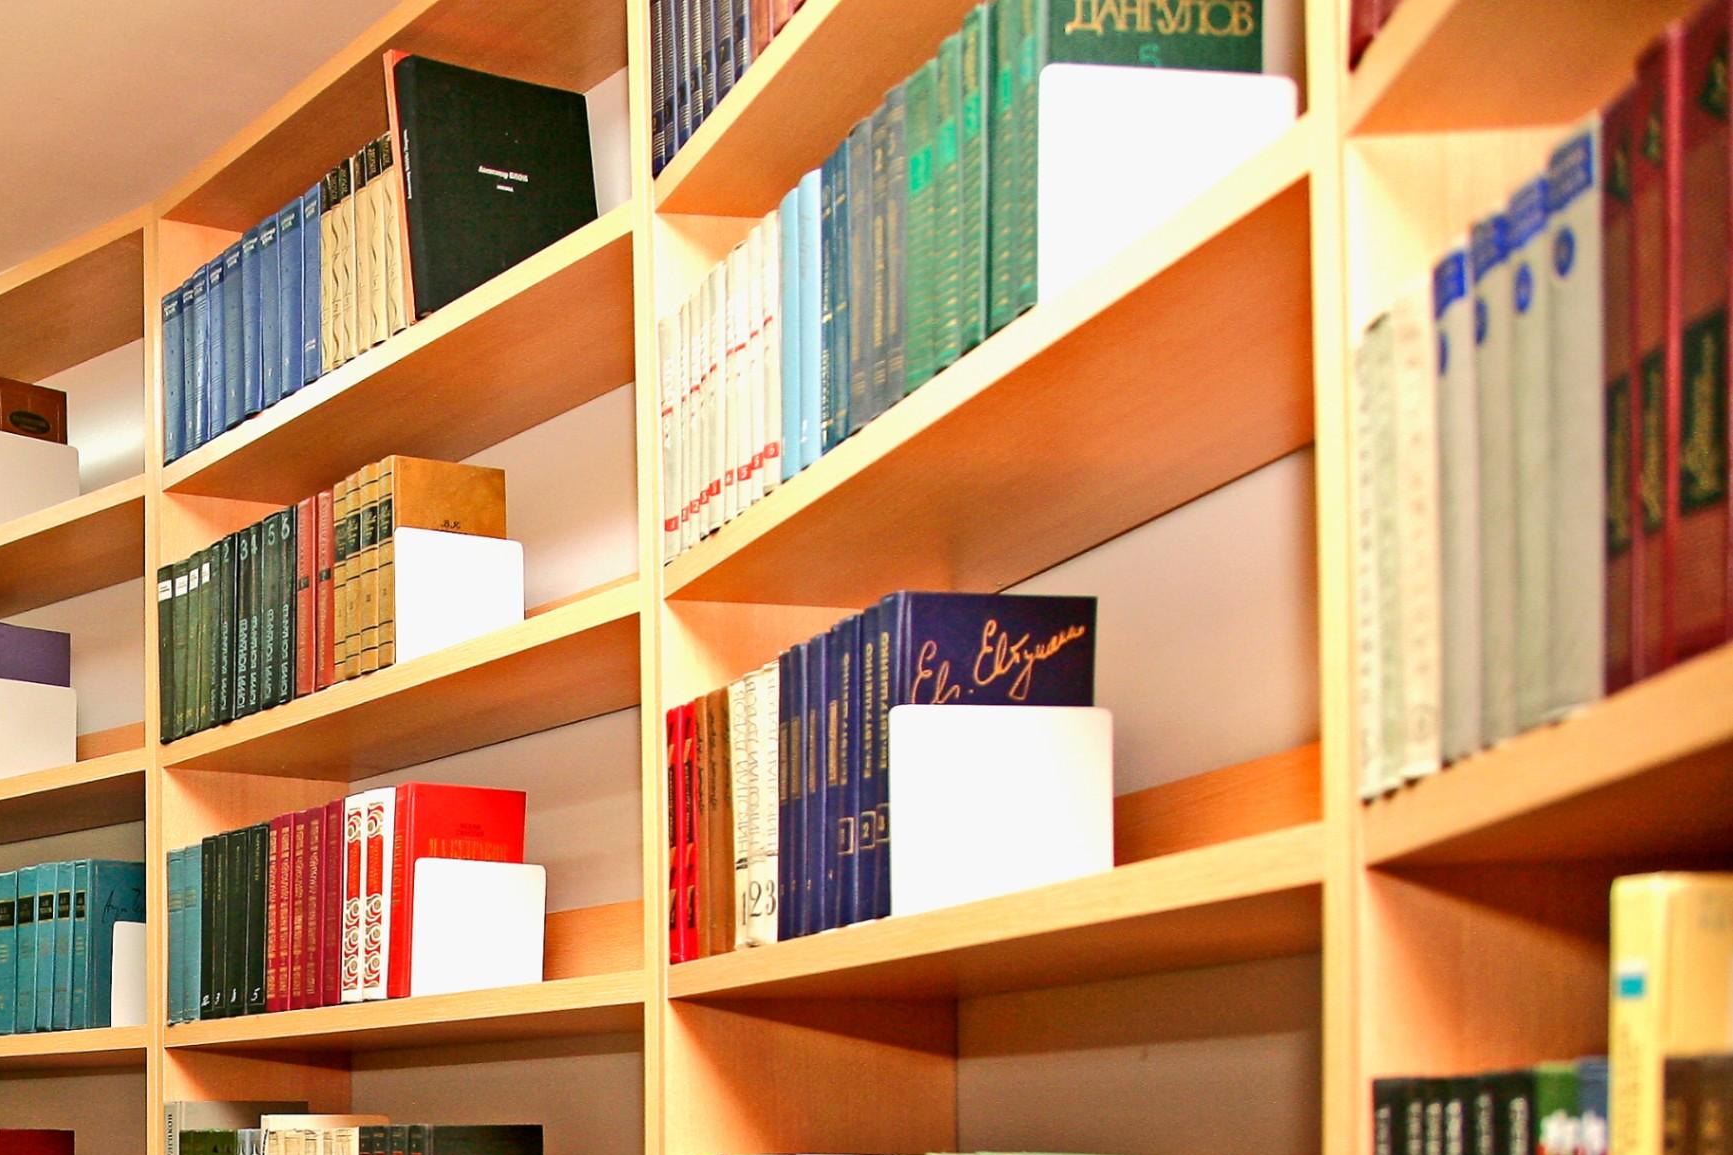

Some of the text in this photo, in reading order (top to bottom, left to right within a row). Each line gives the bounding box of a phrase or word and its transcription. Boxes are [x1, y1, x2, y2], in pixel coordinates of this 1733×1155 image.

[741, 892, 747, 926] 1
[747, 880, 763, 918] 2
[764, 879, 777, 916] 3
[250, 987, 261, 1002] 5
